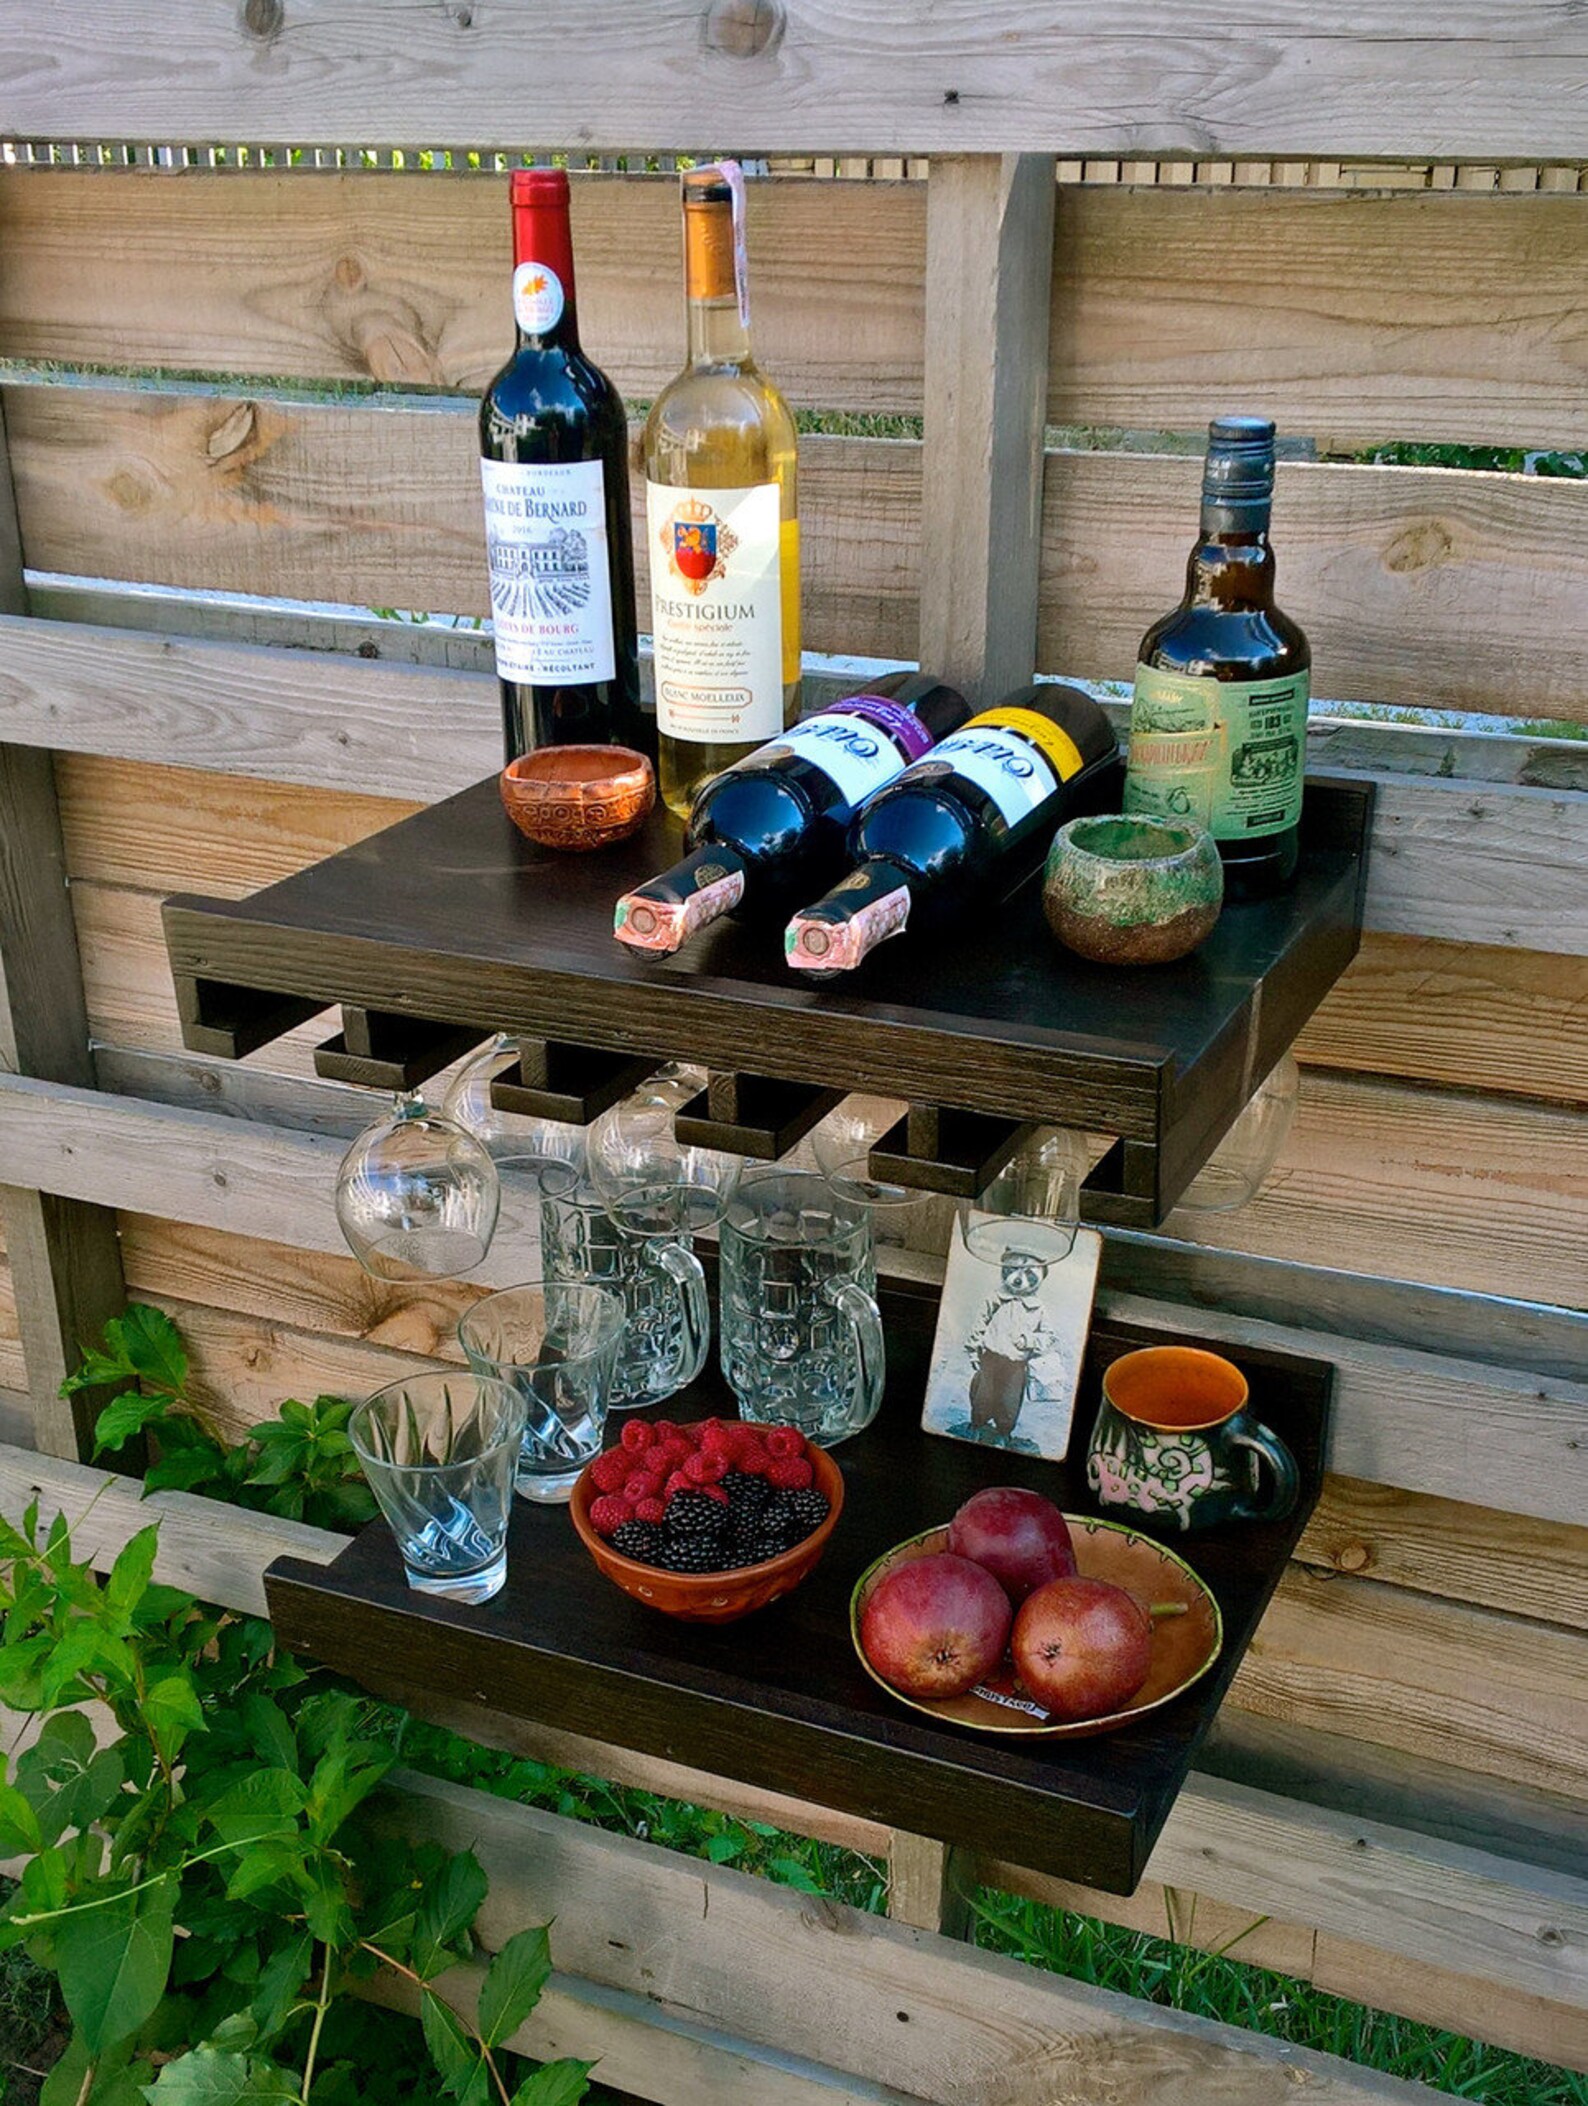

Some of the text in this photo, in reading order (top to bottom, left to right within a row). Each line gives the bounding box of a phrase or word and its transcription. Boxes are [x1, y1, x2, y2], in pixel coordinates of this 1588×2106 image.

[508, 501, 523, 517] DE
[524, 498, 587, 525] BERNARD
[655, 594, 755, 620] PRESTIGIUM
[521, 624, 535, 634] DE
[539, 623, 579, 634] BOURG
[690, 692, 746, 703] MOELLEUX
